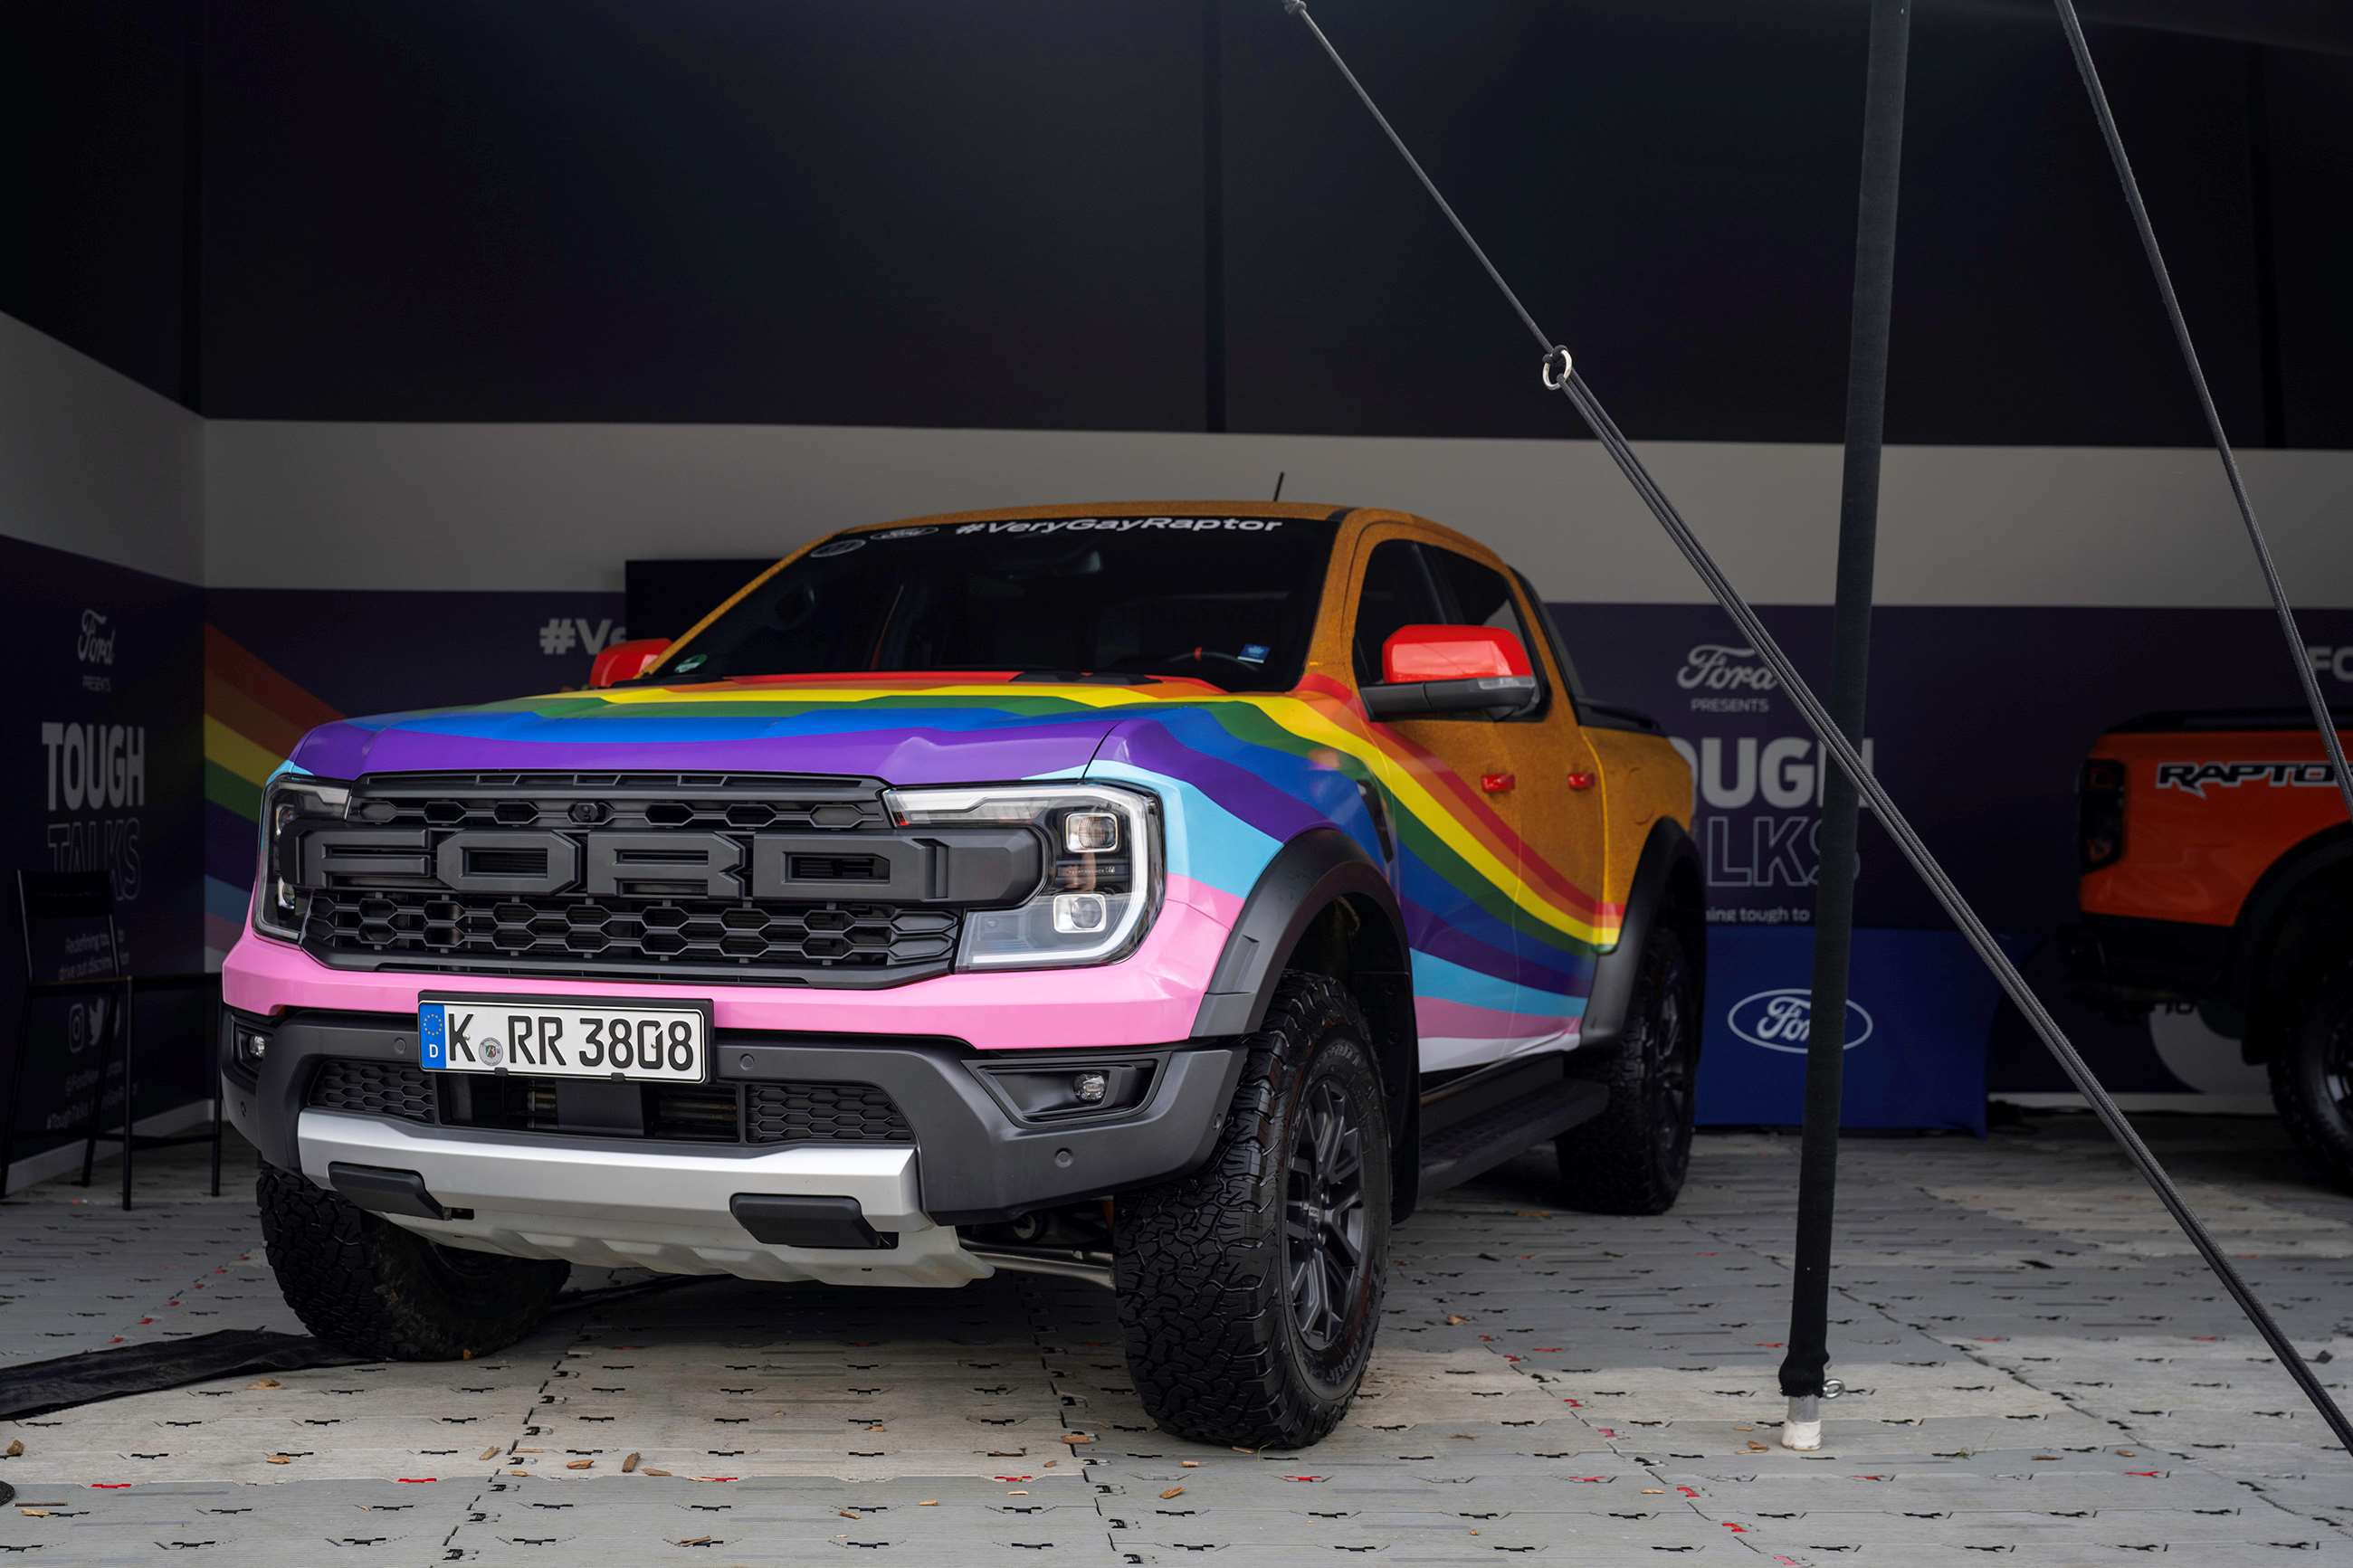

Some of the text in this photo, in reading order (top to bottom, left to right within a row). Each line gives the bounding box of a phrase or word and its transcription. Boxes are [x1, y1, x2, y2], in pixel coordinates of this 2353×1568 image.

[955, 517, 1282, 535] #VeryGayRaptor
[1690, 698, 1769, 713] PRESENTS
[41, 721, 145, 812] TOUGH
[2155, 759, 2353, 800] RAPTO
[299, 826, 927, 903] FORD
[1739, 906, 1789, 925] tough
[1792, 908, 1811, 923] to
[429, 1043, 440, 1059] D
[448, 1013, 476, 1062] K
[508, 1015, 567, 1066] RR
[578, 1017, 694, 1071] 3808
